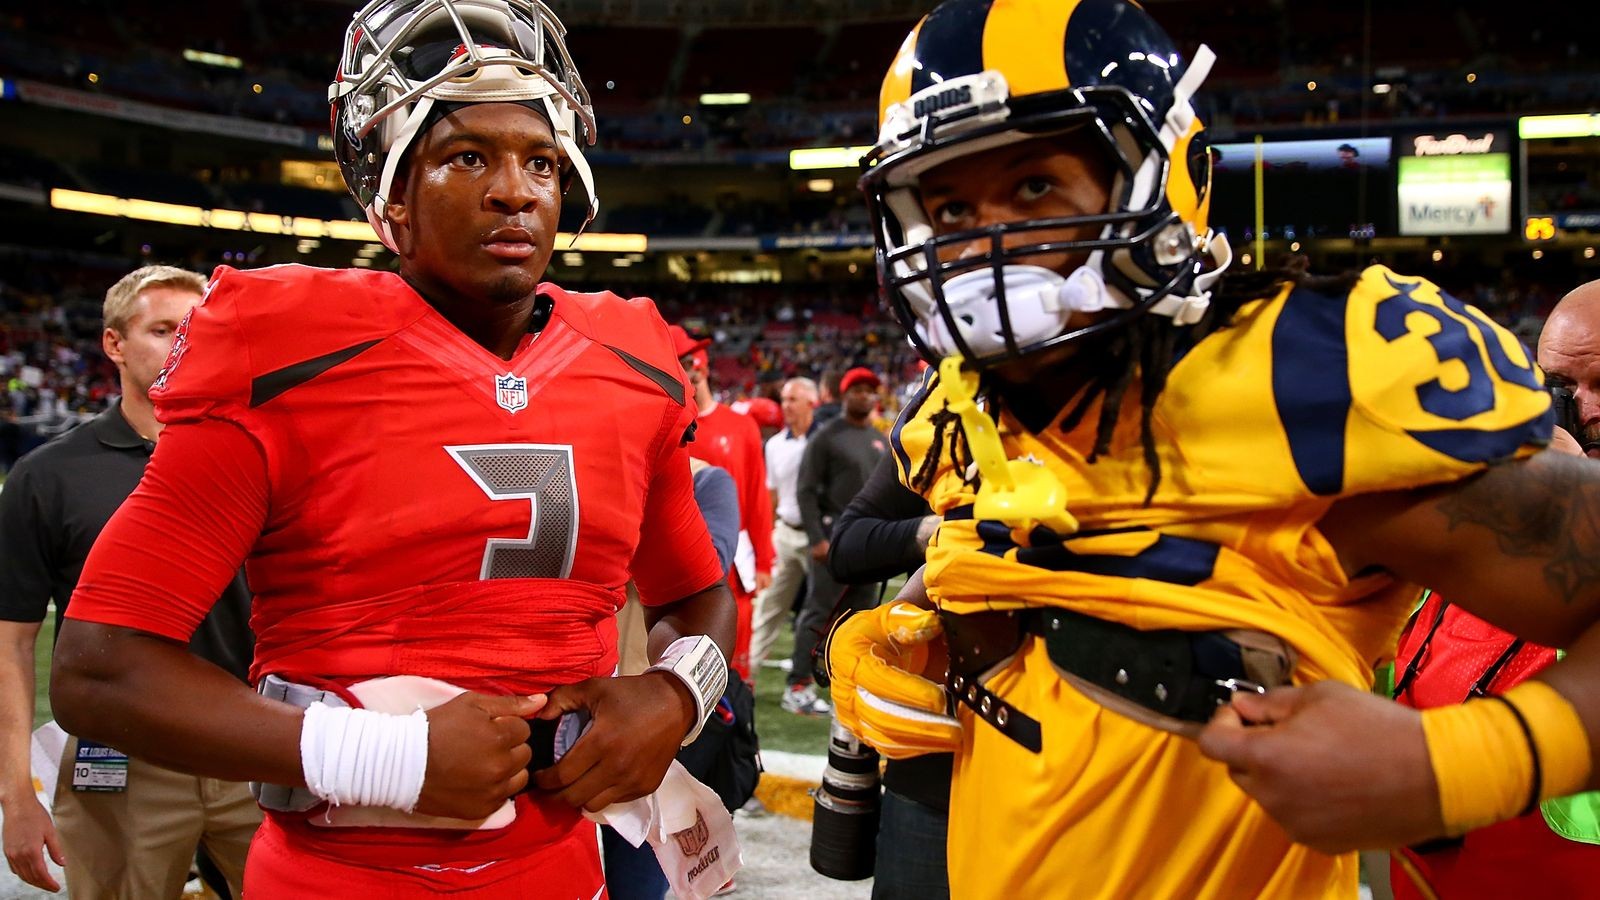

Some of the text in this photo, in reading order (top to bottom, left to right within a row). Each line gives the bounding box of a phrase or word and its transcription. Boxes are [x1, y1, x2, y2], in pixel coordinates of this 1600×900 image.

[1408, 202, 1476, 227] Mercy
[1374, 287, 1546, 421] 30
[501, 390, 523, 406] NFL
[89, 747, 109, 758] LOUIS
[76, 767, 89, 778] 10
